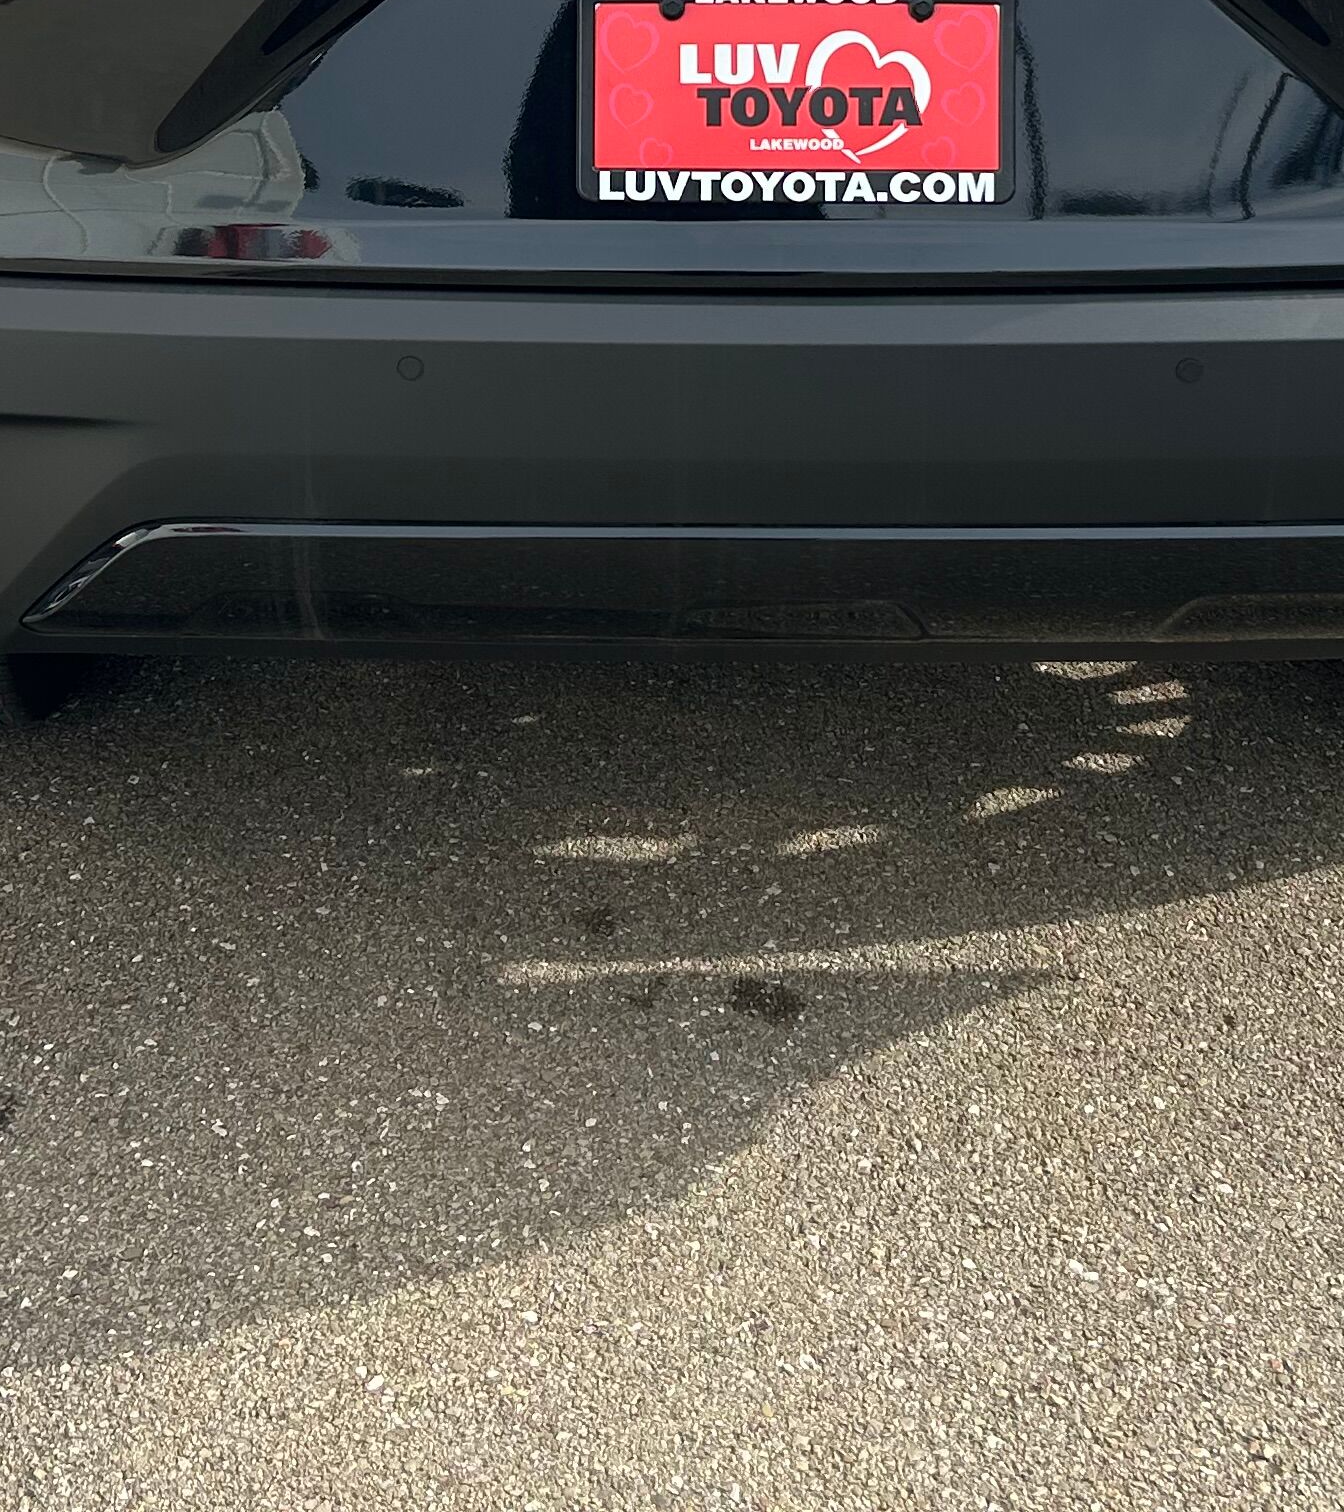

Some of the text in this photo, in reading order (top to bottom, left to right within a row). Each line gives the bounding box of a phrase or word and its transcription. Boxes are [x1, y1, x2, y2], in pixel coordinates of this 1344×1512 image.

[679, 43, 800, 85] LUV
[697, 86, 923, 127] TOYOTA
[749, 137, 845, 152] LAKEWOOD
[598, 171, 996, 203] LUVTOYOTA.COM
